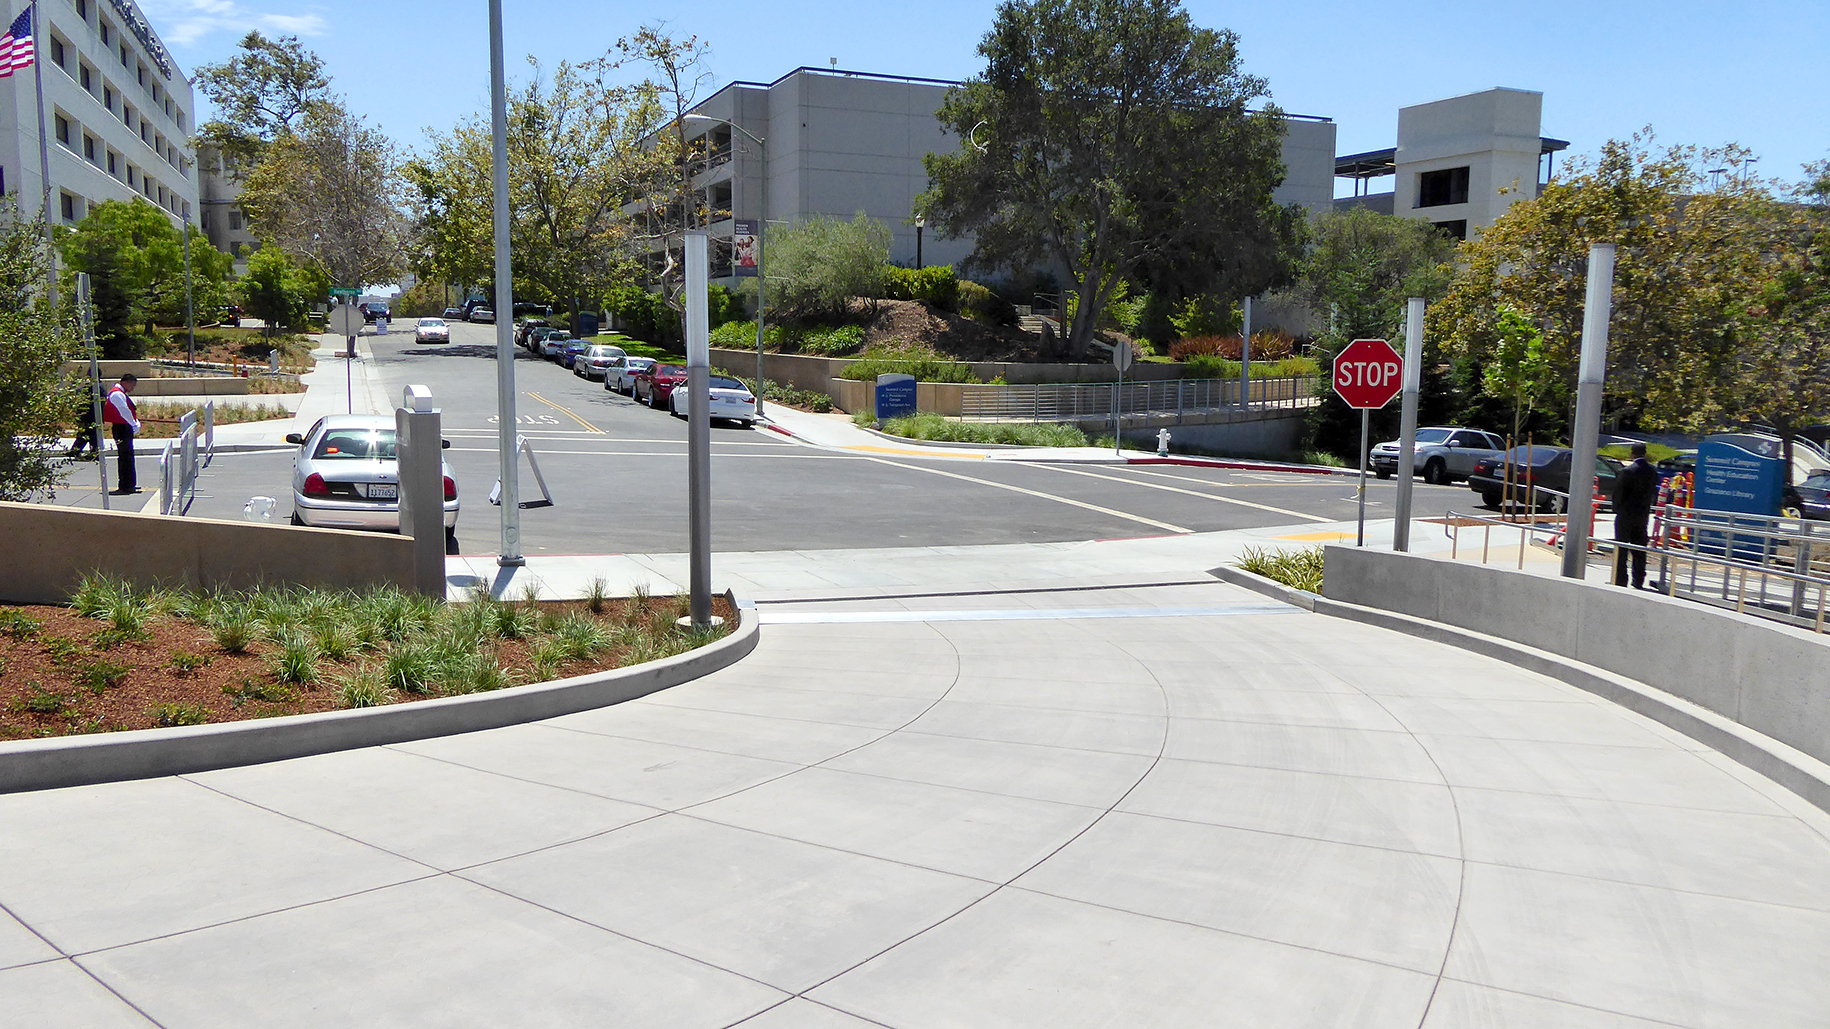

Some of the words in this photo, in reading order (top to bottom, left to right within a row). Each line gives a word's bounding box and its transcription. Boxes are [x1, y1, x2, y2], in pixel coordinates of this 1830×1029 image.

[1338, 361, 1399, 387] STOP
[1705, 455, 1731, 465] Summit
[1731, 457, 1761, 468] Campus
[1705, 476, 1726, 484] Center
[1706, 469, 1726, 477] Health
[1726, 470, 1759, 480] Education
[1732, 490, 1756, 500] Library
